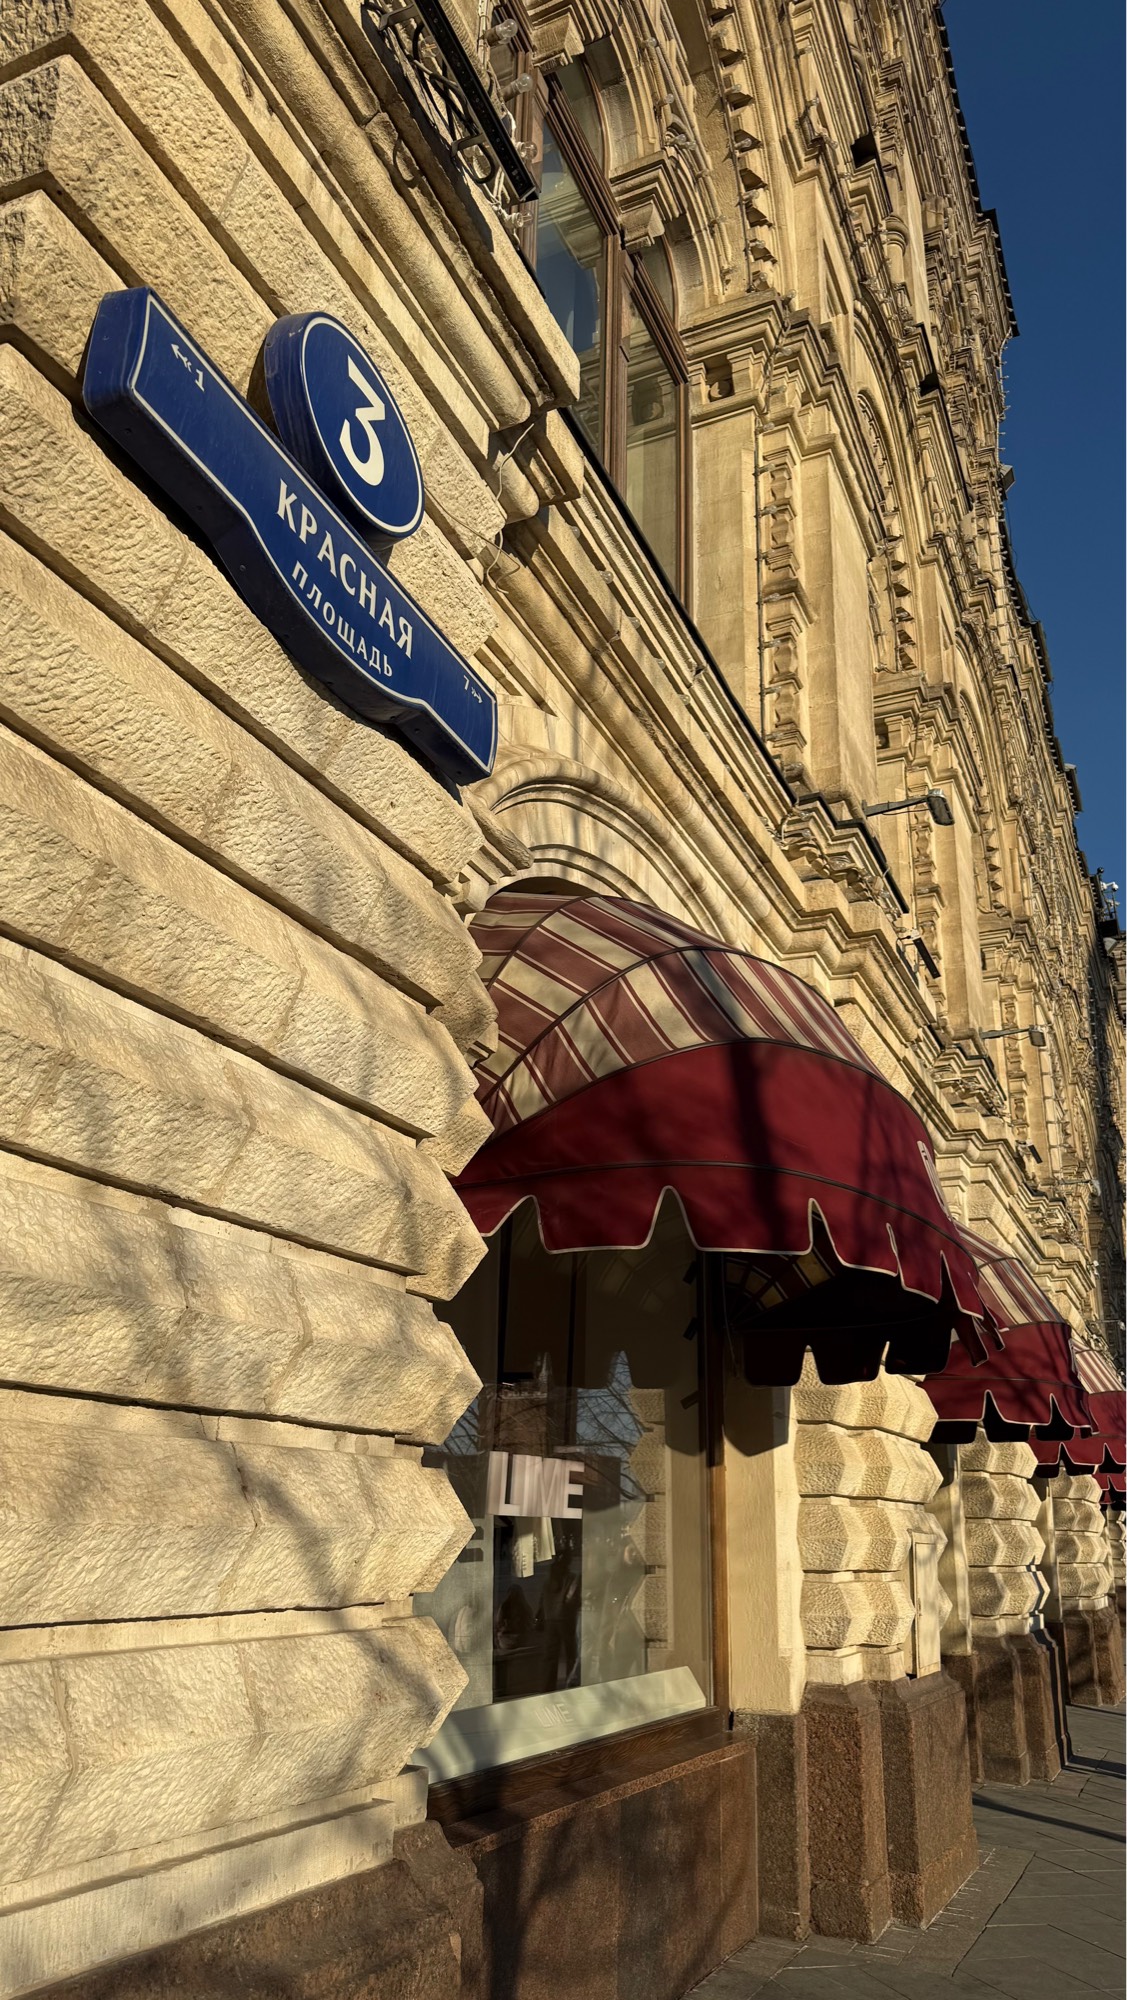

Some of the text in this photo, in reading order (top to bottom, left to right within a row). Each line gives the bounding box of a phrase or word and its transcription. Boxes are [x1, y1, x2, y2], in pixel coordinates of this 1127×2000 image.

[194, 368, 205, 392] 1
[339, 354, 386, 487] 3
[276, 478, 414, 660] КРАСНАЯ
[291, 560, 394, 678] ПЛОЩАДЬ
[463, 674, 470, 691] 7
[486, 1451, 586, 1520] LIME
[534, 1702, 576, 1729] LIME
